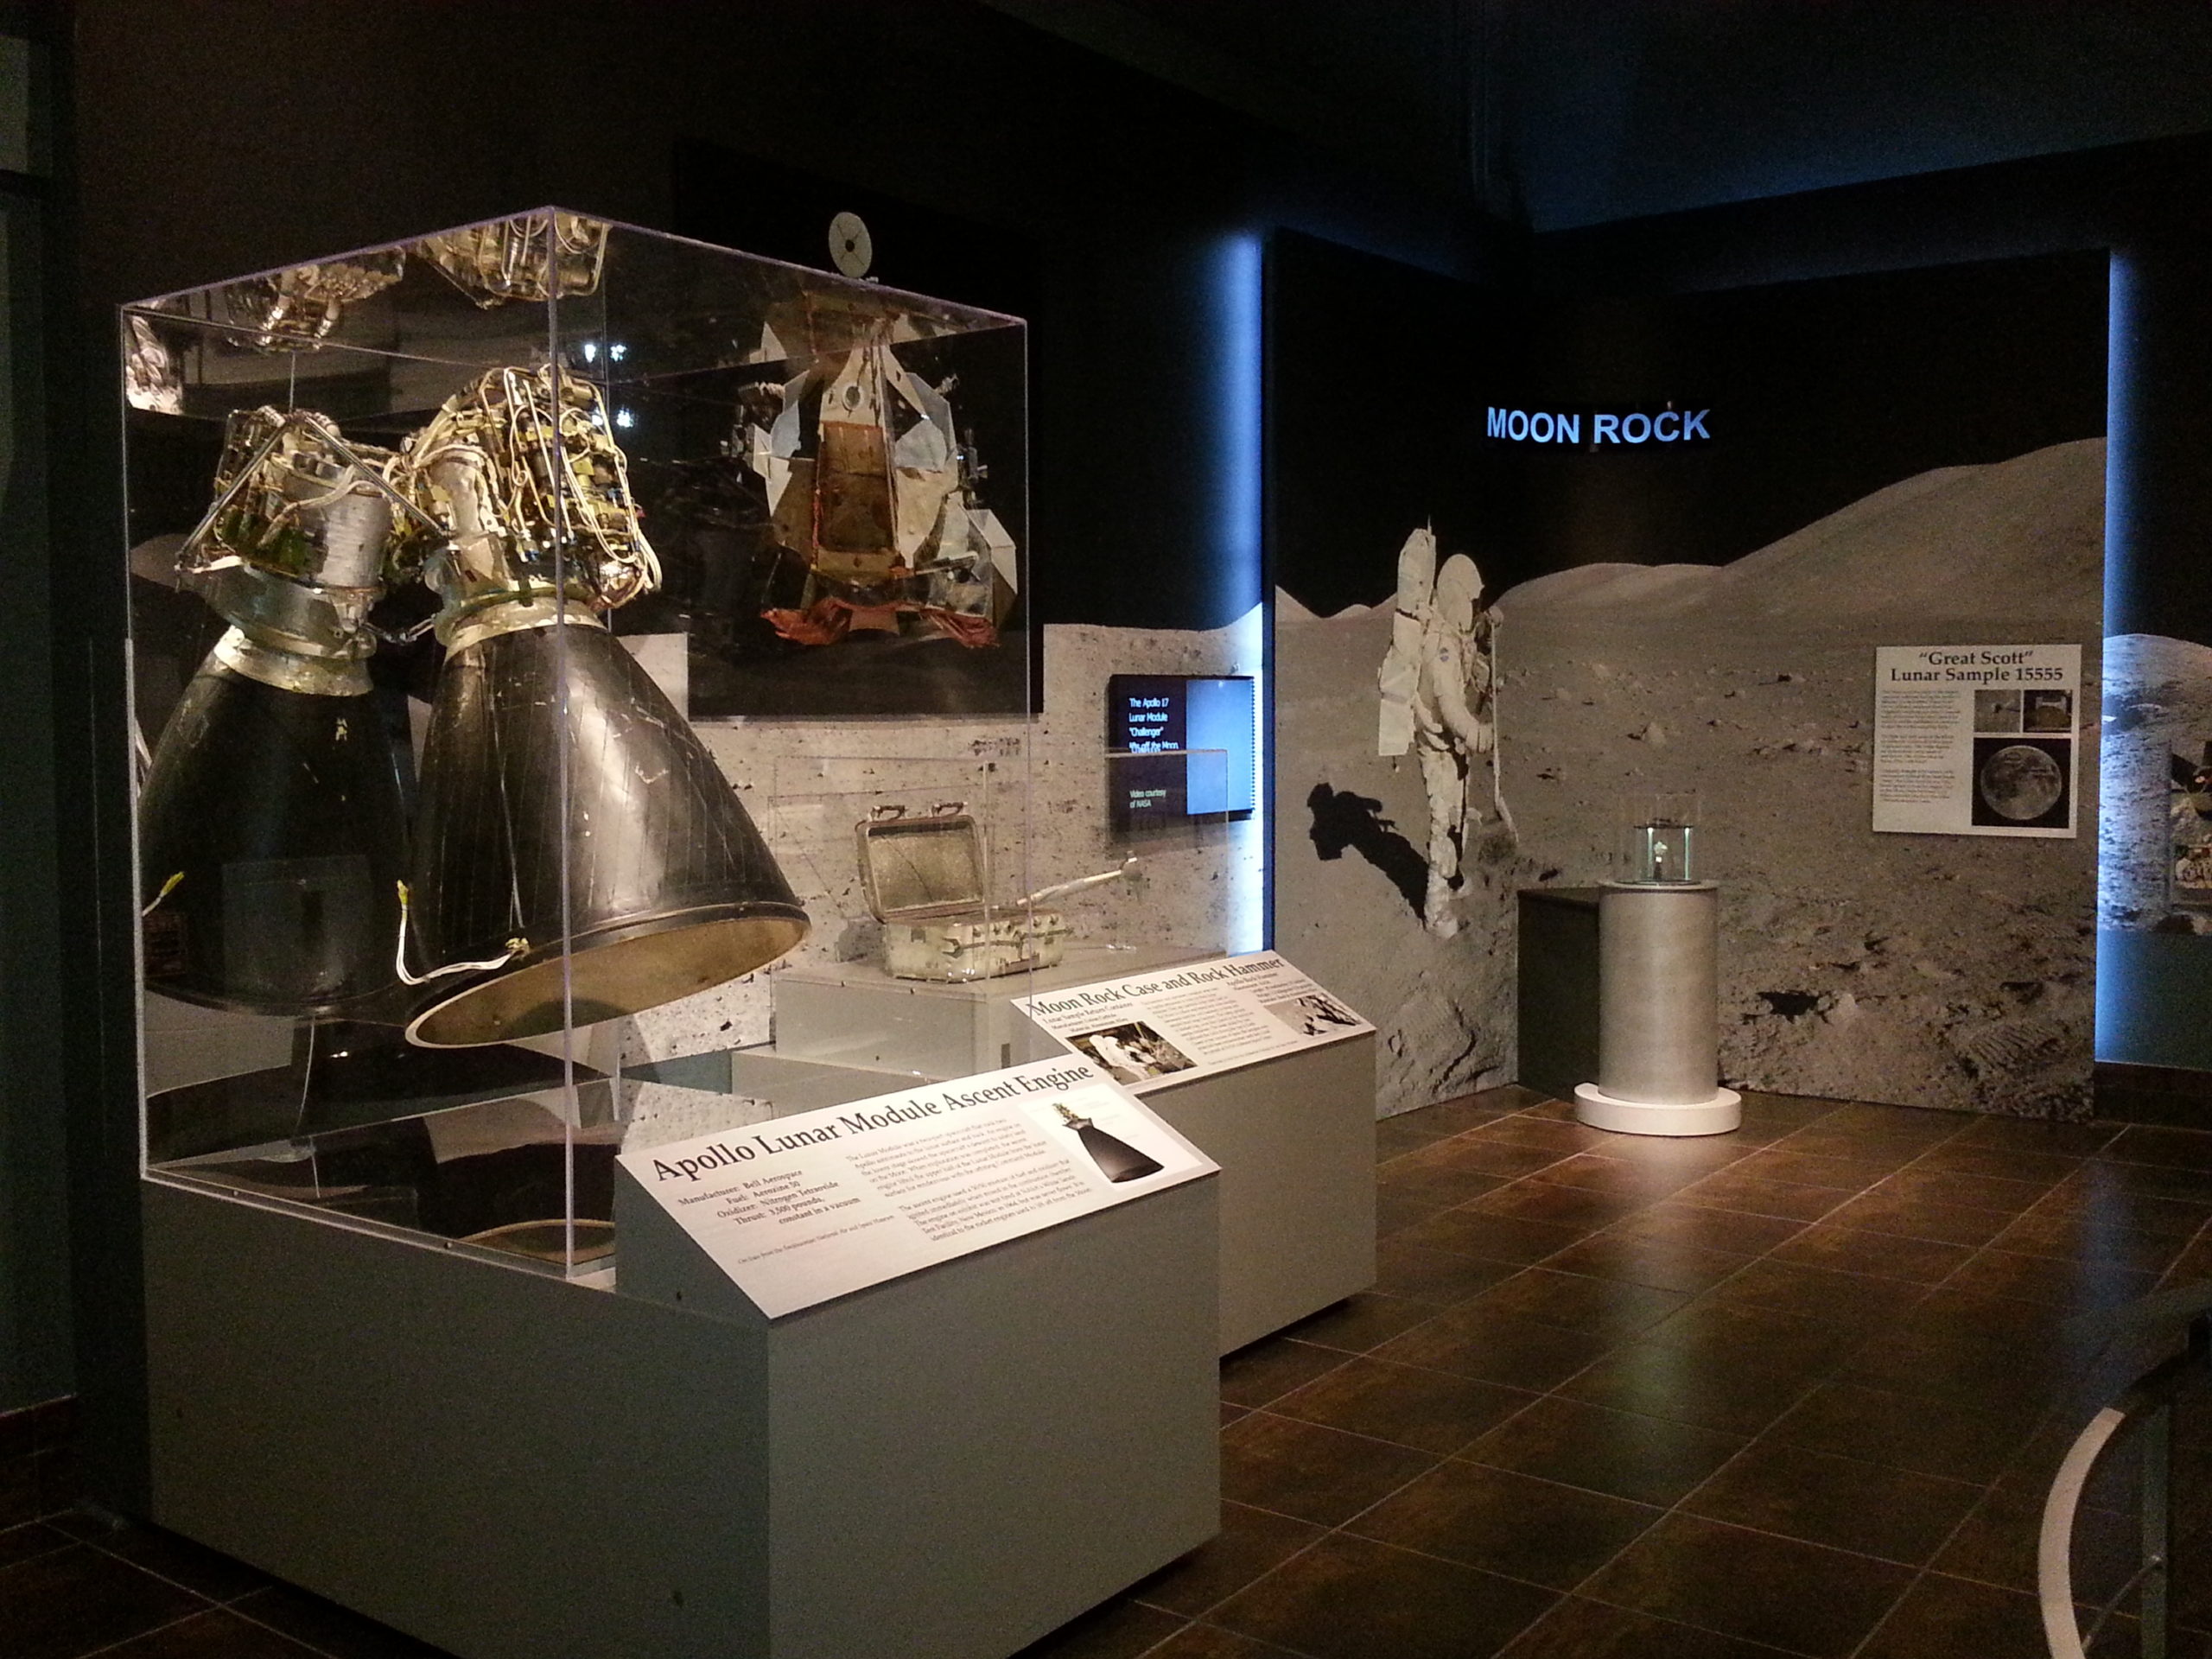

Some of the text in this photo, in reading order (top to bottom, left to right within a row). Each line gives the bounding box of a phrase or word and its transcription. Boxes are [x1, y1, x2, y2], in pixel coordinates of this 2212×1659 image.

[1487, 406, 1711, 444] MOON ROCK
[1891, 667, 2063, 685] Lunar Sample 15555
[1128, 697, 1169, 709] The Apollo 17
[1128, 712, 1168, 722] Lunar Module
[1136, 799, 1152, 808] NASA
[1026, 999, 1084, 1015] Moon
[1078, 988, 1126, 1005] Rock
[1122, 983, 1163, 996] Case
[1161, 975, 1192, 989] and
[1186, 968, 1230, 983] Rock
[1222, 959, 1284, 976] Hammer
[653, 1067, 1094, 1181] Apollo Lunar Module Ascent Engine
[762, 1171, 802, 1185] Aerospace
[760, 1193, 798, 1206] Nitrogen
[779, 1210, 813, 1224] constant
[830, 1198, 861, 1210] vacuum
